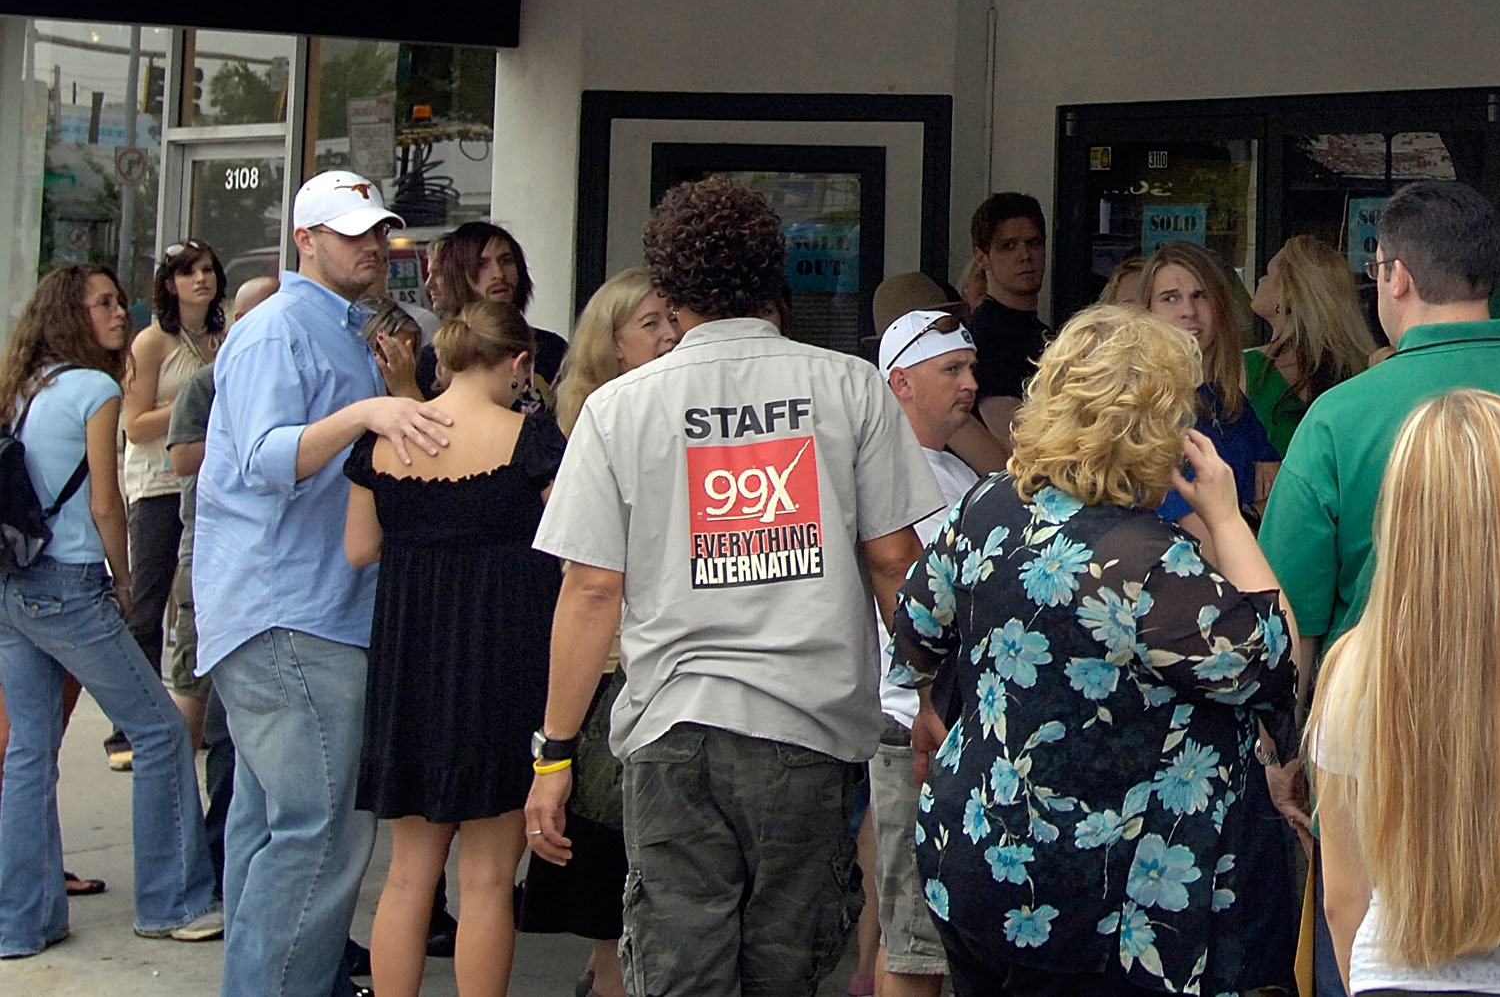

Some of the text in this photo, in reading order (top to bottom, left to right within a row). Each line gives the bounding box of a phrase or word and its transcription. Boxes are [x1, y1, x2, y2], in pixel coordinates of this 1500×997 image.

[1149, 151, 1167, 168] 3110
[225, 167, 259, 190] 3108
[1150, 214, 1198, 232] SOLD
[796, 259, 847, 276] OUT
[684, 398, 812, 440] STAFF
[704, 439, 811, 523] 99X
[692, 522, 820, 559] EVERYTHING
[695, 547, 821, 585] ALTERNATIVE
